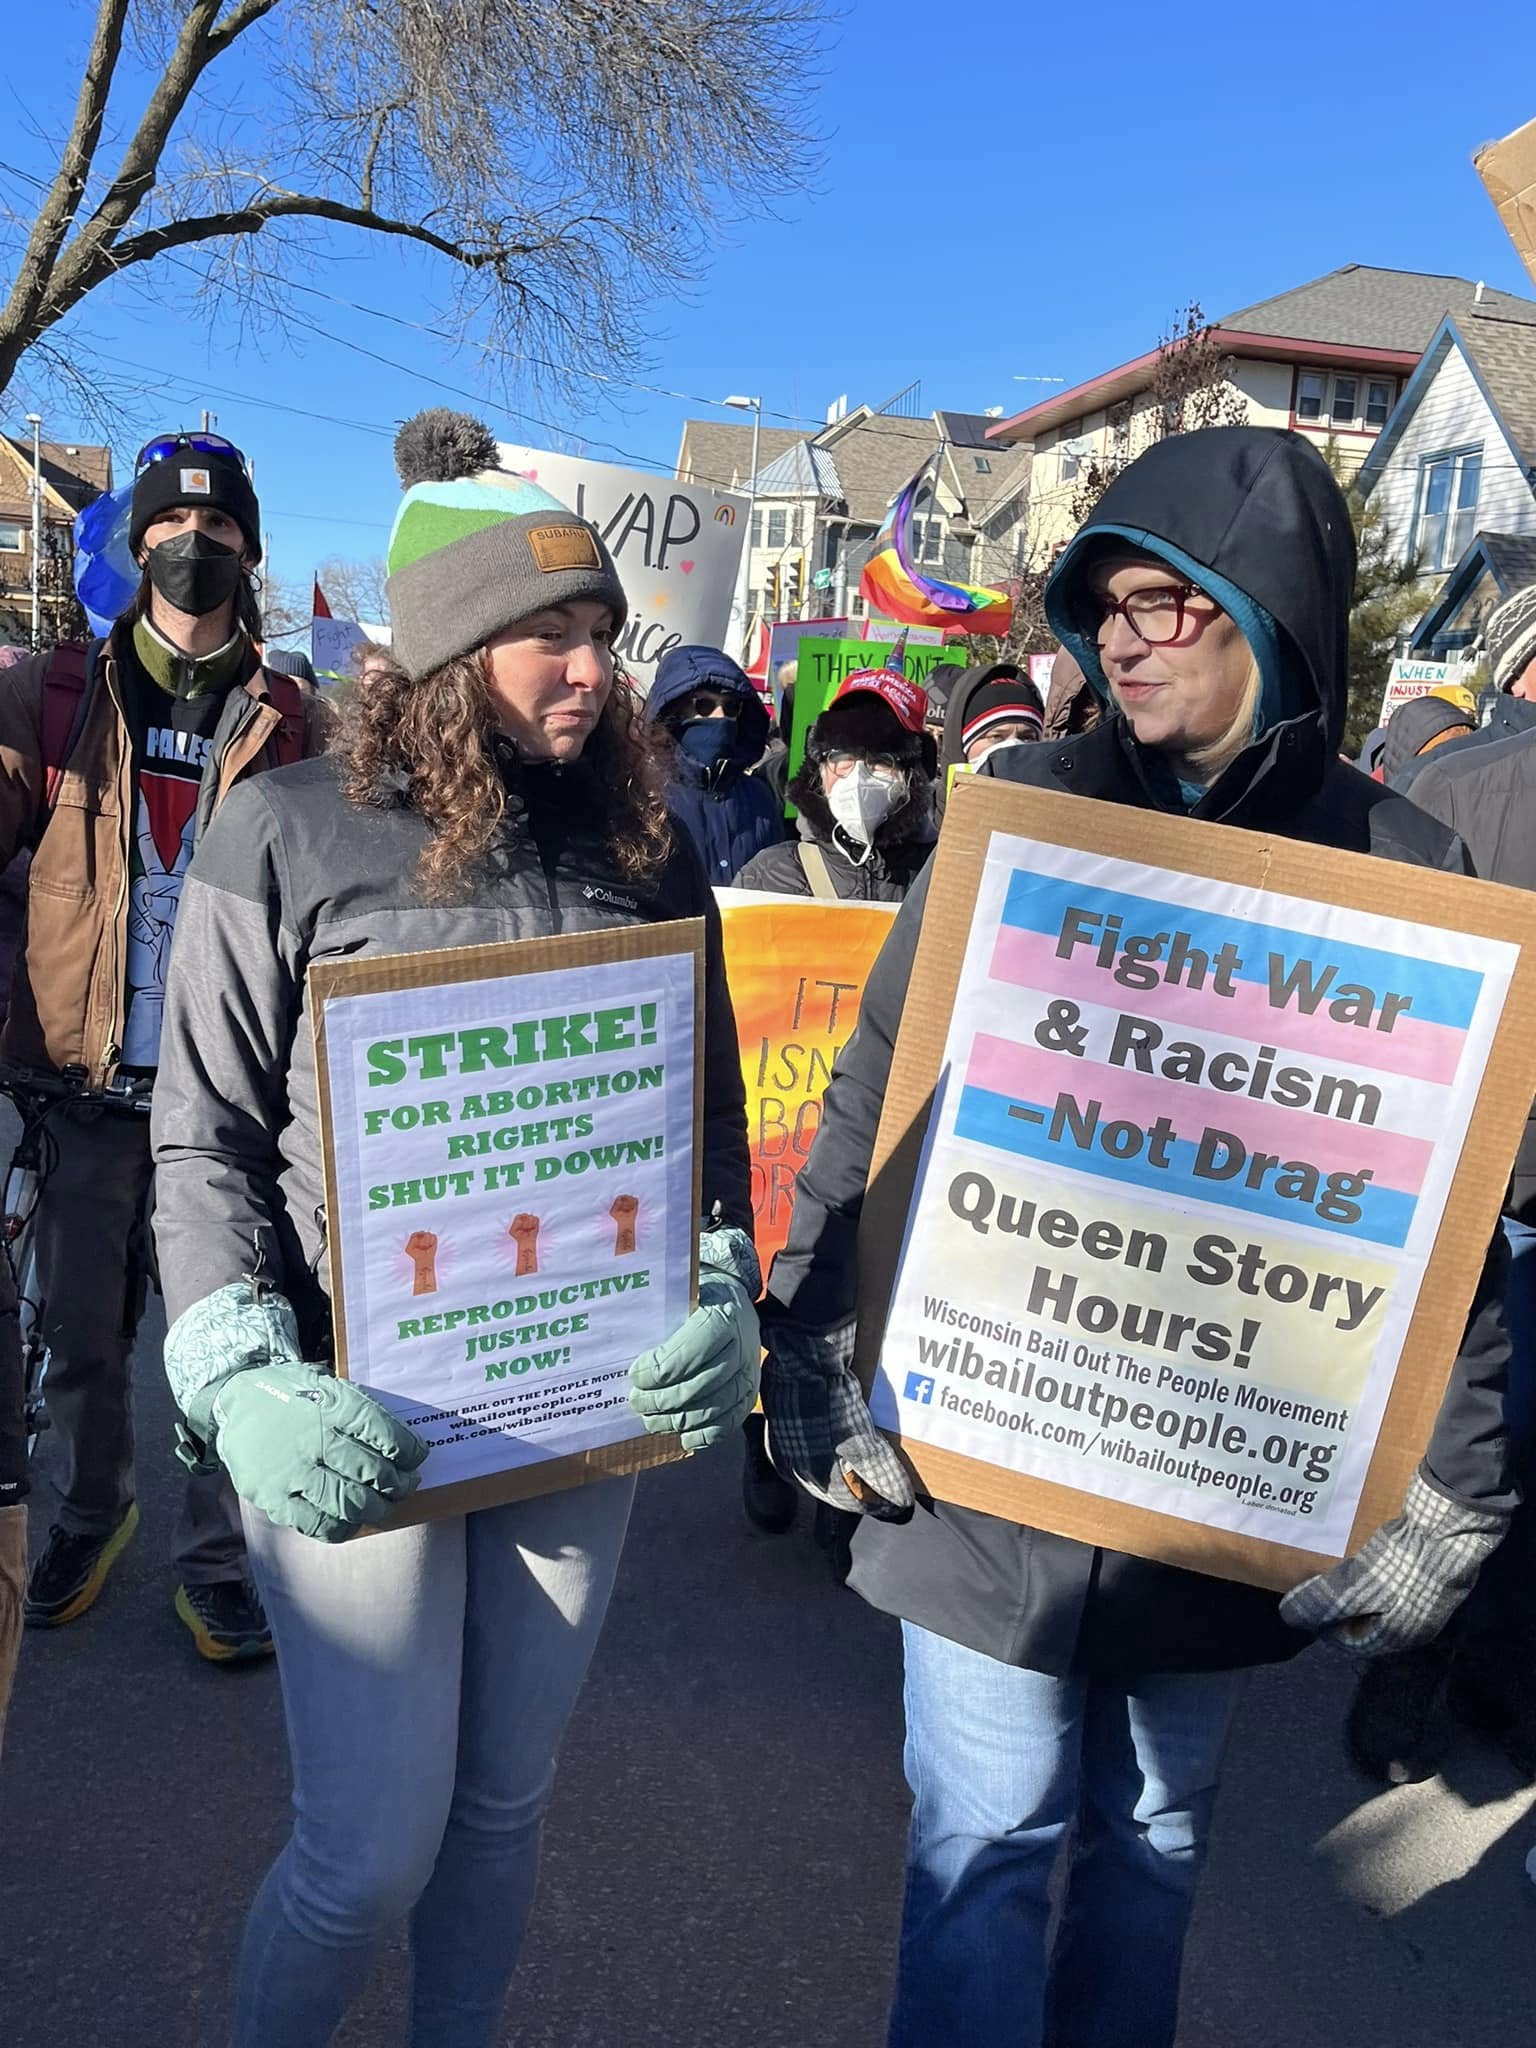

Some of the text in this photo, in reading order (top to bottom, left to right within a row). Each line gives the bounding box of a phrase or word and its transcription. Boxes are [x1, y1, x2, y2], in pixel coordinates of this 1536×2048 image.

[536, 528, 585, 540] SUBARU
[812, 653, 874, 683] THEY
[1389, 685, 1432, 697] INJUST
[1399, 664, 1448, 680] WHEN
[146, 726, 213, 769] PALES
[594, 887, 638, 910] Columbia
[1056, 906, 1413, 1033] Fight War
[792, 977, 858, 1034] IT
[366, 1002, 657, 1088] STRIKE!
[757, 1036, 840, 1093] ISN
[1034, 999, 1382, 1126] & Racism
[364, 1064, 665, 1136] FOR ABORTION
[447, 1113, 594, 1160] RIGHTS
[368, 1135, 665, 1211] SHUT IT DOWN!
[1193, 1126, 1374, 1225] Drag
[947, 1171, 1386, 1331] Queen Story
[397, 1269, 650, 1341] REPRODUCTIVE
[1026, 1266, 1261, 1370] Hours!
[465, 1312, 589, 1361] JUSTICE
[484, 1346, 571, 1382] NOW!
[923, 1295, 1349, 1432] Wisconsin Bail Out The People Movement
[406, 1408, 459, 1427] SCONSIN
[462, 1403, 490, 1416] BAIL
[492, 1396, 516, 1408] OUT
[516, 1390, 541, 1403] THE
[543, 1378, 589, 1397] PEOPLE
[426, 1396, 629, 1449] book.com/wibailoutpeople.
[450, 1388, 603, 1431] wibailoutpeople.org
[918, 1335, 1337, 1483] wibailoutpeople.org
[940, 1386, 1318, 1514] facebook.com/wibailoutpeople.org
[1241, 1499, 1297, 1517] Labor donated
